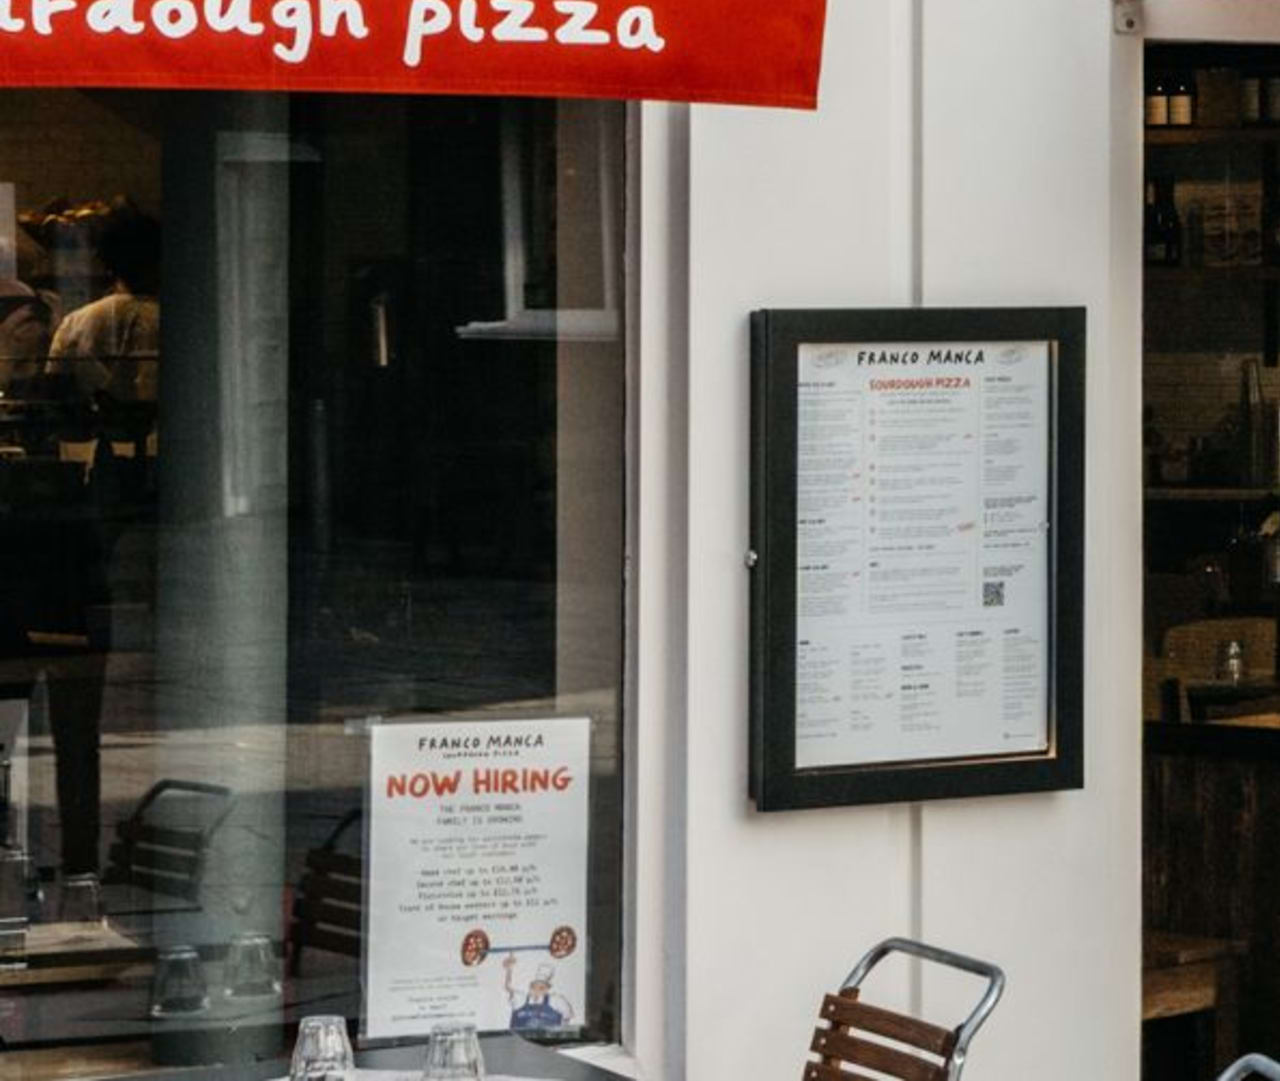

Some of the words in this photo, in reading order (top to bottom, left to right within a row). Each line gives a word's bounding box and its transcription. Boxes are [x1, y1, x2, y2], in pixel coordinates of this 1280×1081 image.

[856, 350, 919, 366] FRANCO
[926, 349, 986, 366] MANCA
[869, 377, 933, 392] SOURDOUGH
[935, 377, 971, 390] PIZZA
[418, 736, 481, 752] FRANCO
[486, 734, 545, 749] MANCA
[386, 770, 462, 799] NOW
[472, 766, 573, 795] HIRING
